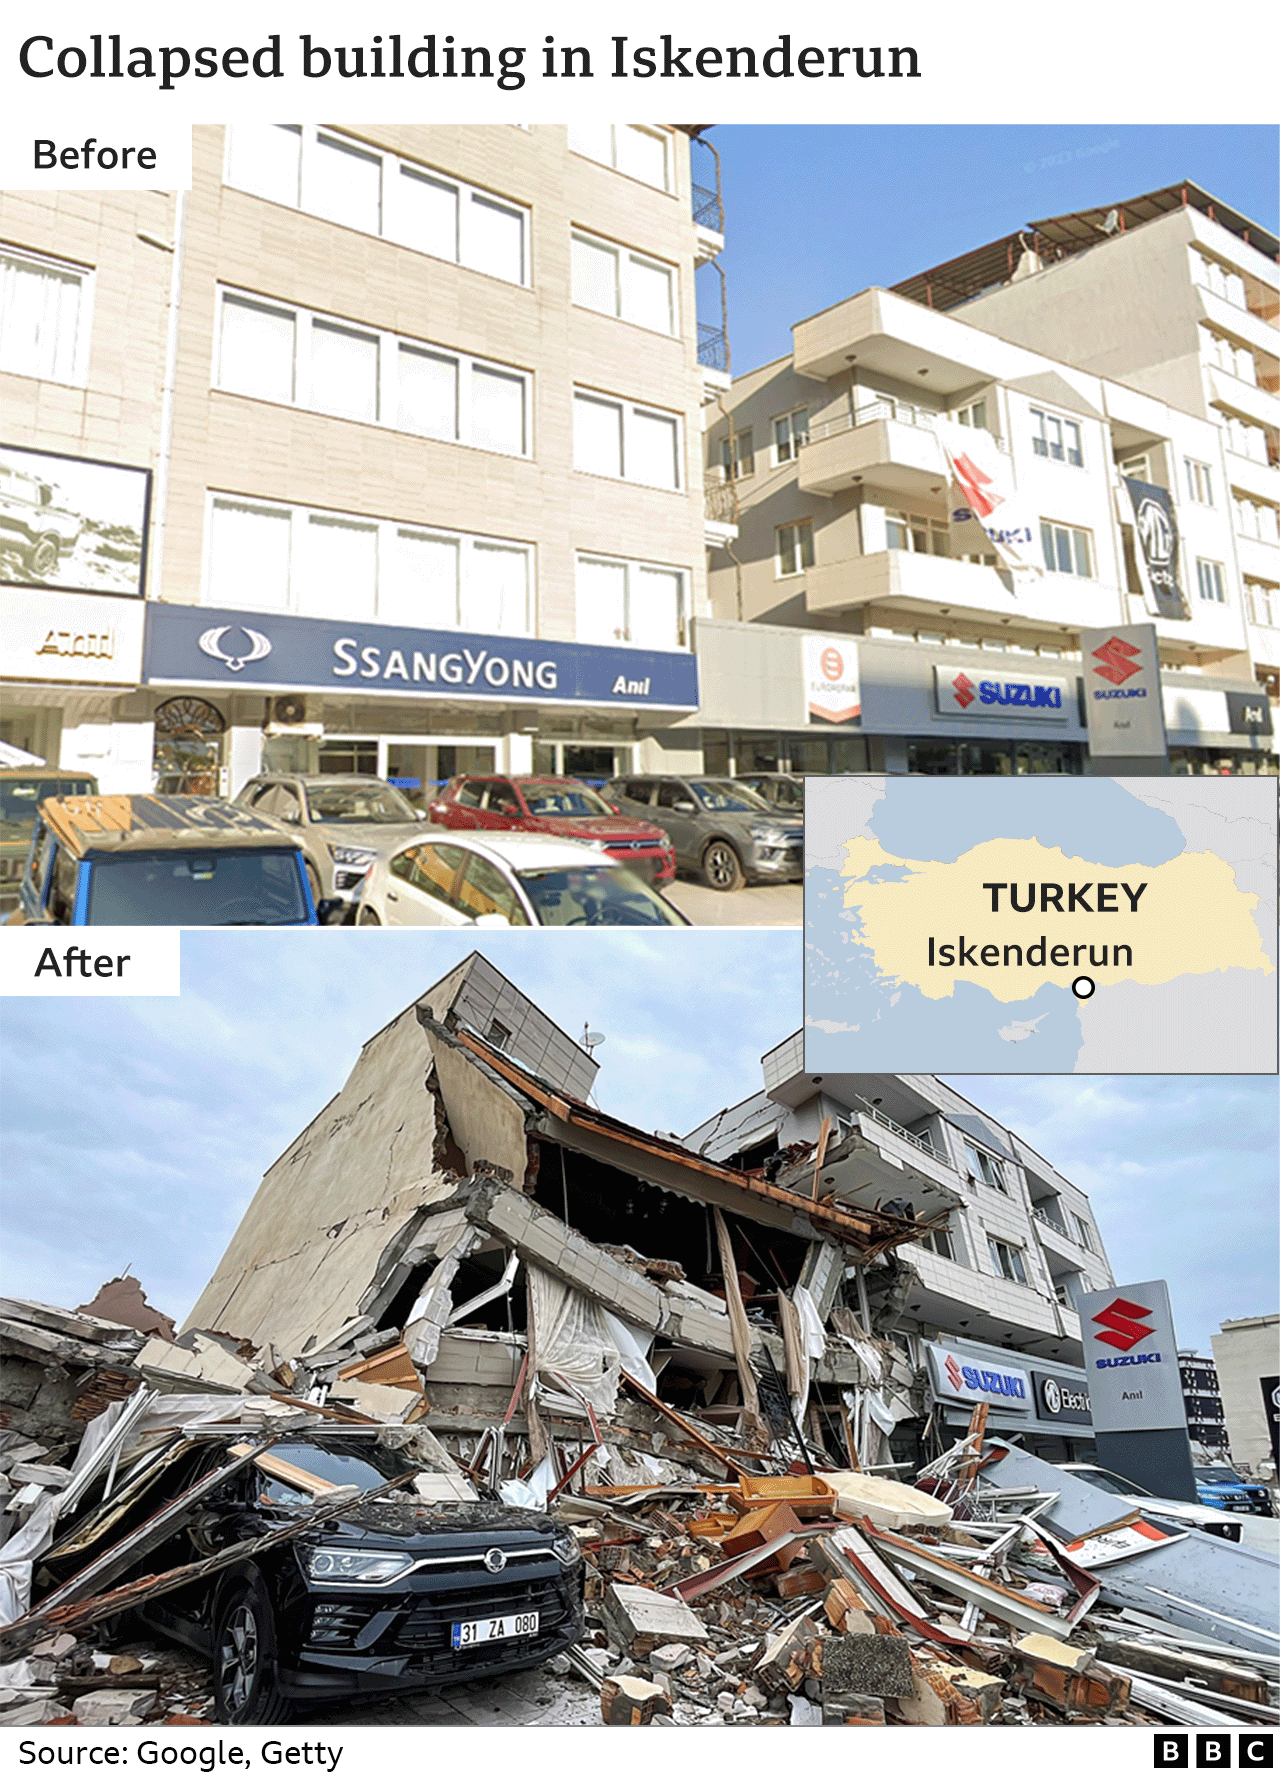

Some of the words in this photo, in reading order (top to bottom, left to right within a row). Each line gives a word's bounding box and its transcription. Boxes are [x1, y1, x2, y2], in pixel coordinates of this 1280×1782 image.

[979, 681, 1062, 708] SUZUKI
[1093, 688, 1147, 700] SUZUKI
[1095, 1353, 1162, 1370] SUZUKI
[962, 1366, 1026, 1399] SUZUKI
[462, 1623, 477, 1642] 31
[489, 1620, 505, 1638] ZA
[515, 1614, 537, 1633] 080
